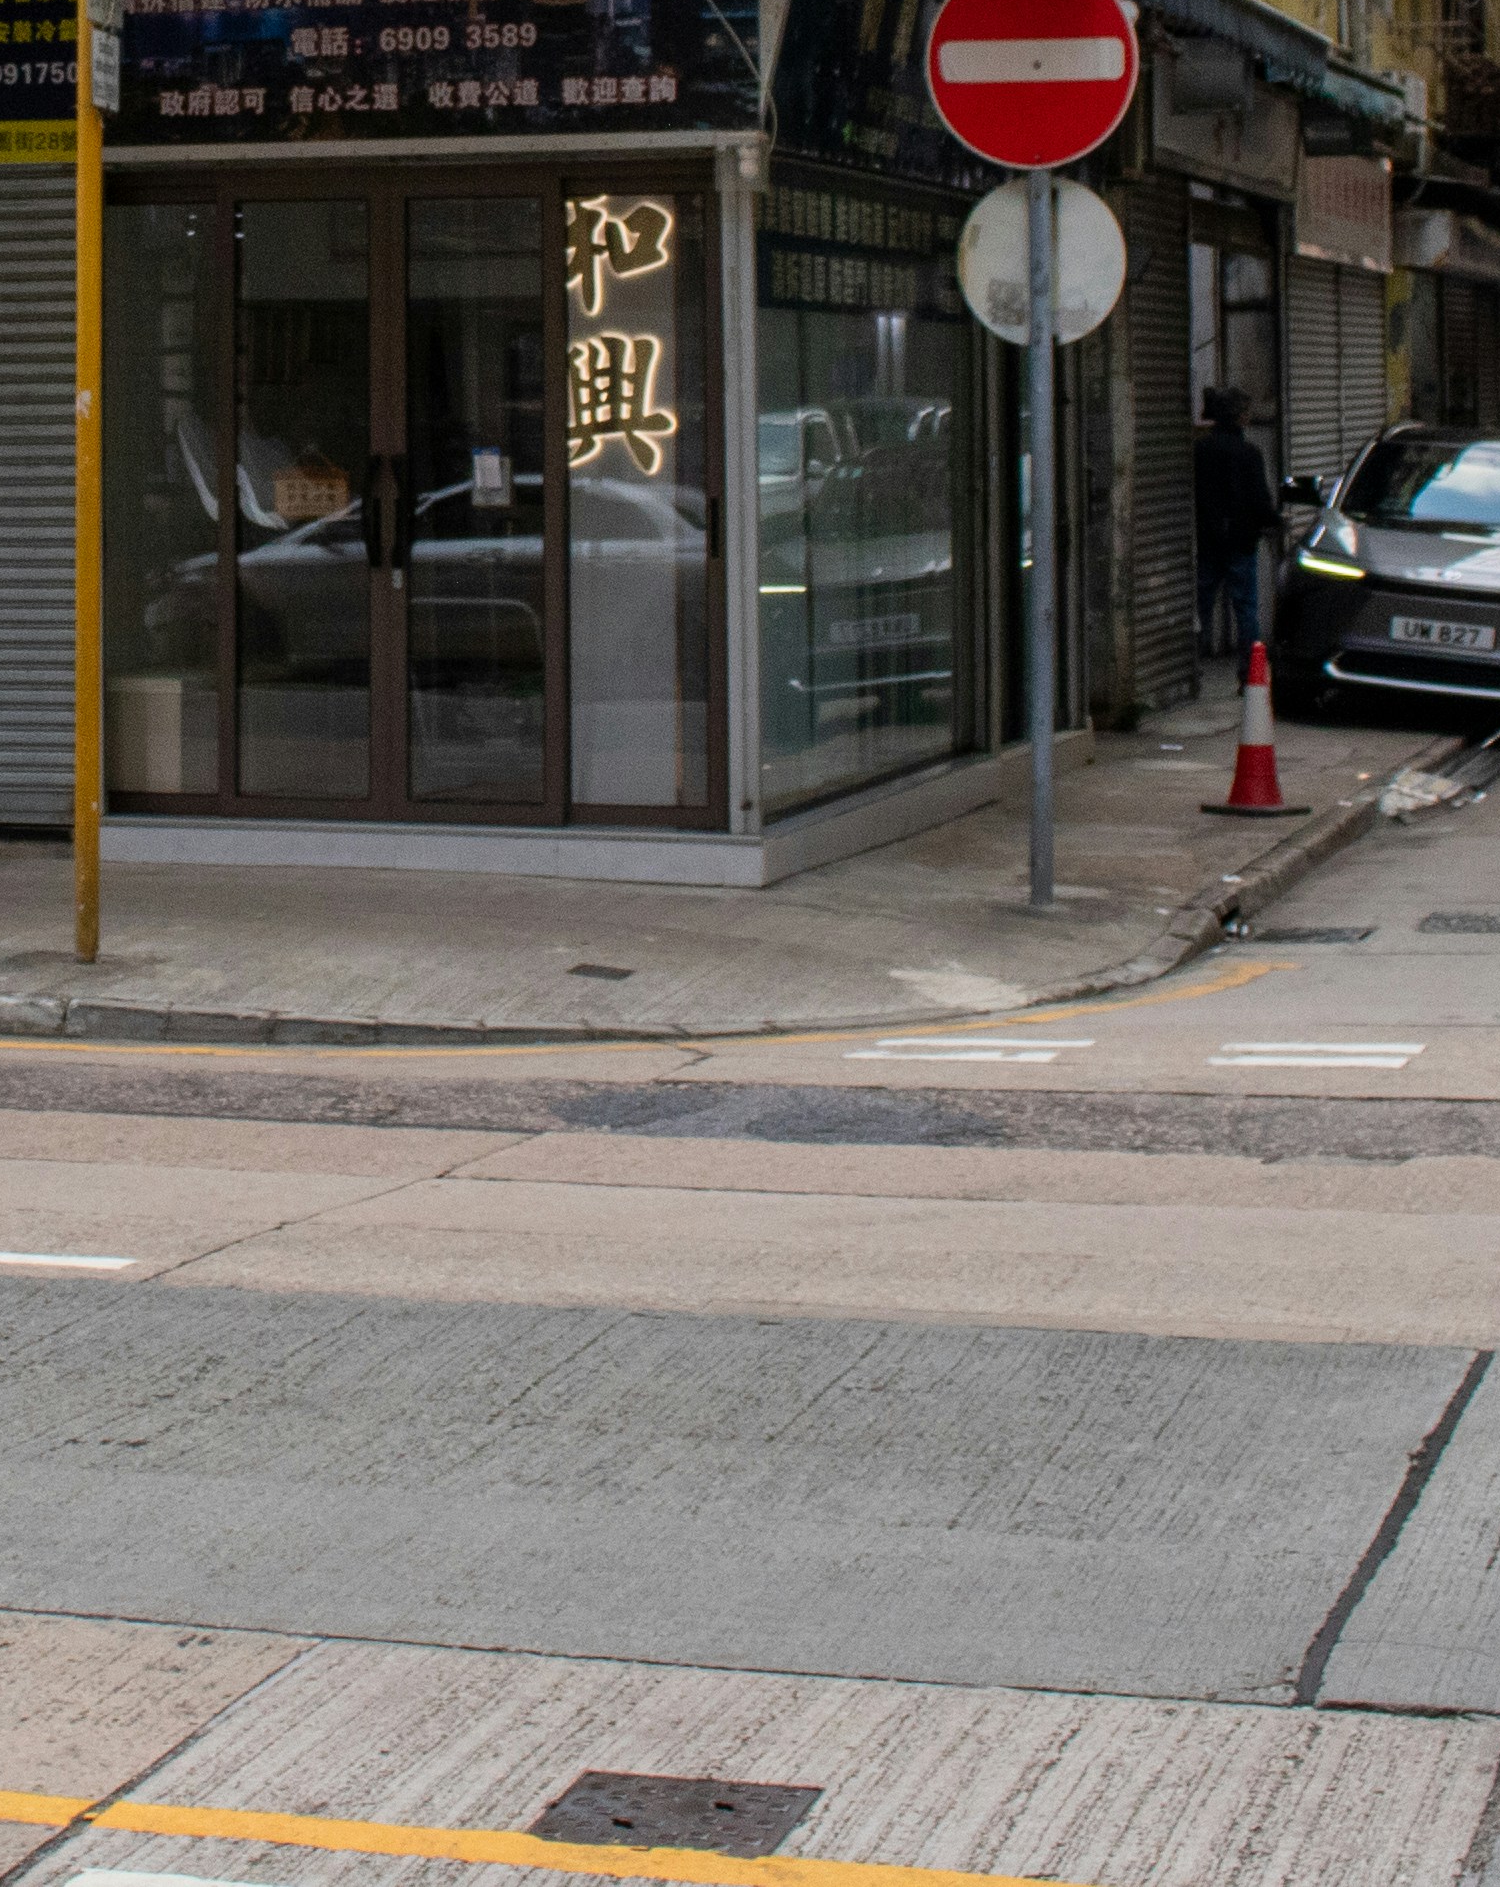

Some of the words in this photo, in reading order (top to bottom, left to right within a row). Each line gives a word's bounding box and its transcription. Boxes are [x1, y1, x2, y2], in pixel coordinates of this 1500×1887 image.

[379, 26, 451, 52] 6909
[465, 22, 537, 49] 3589
[160, 86, 267, 117] 政府認可
[289, 83, 400, 114] 信心之選
[428, 77, 540, 108] 收費公道
[561, 74, 679, 106] 歡迎查詢
[566, 194, 678, 475] 和興
[1401, 620, 1435, 644] UW
[1440, 623, 1480, 647] 827
